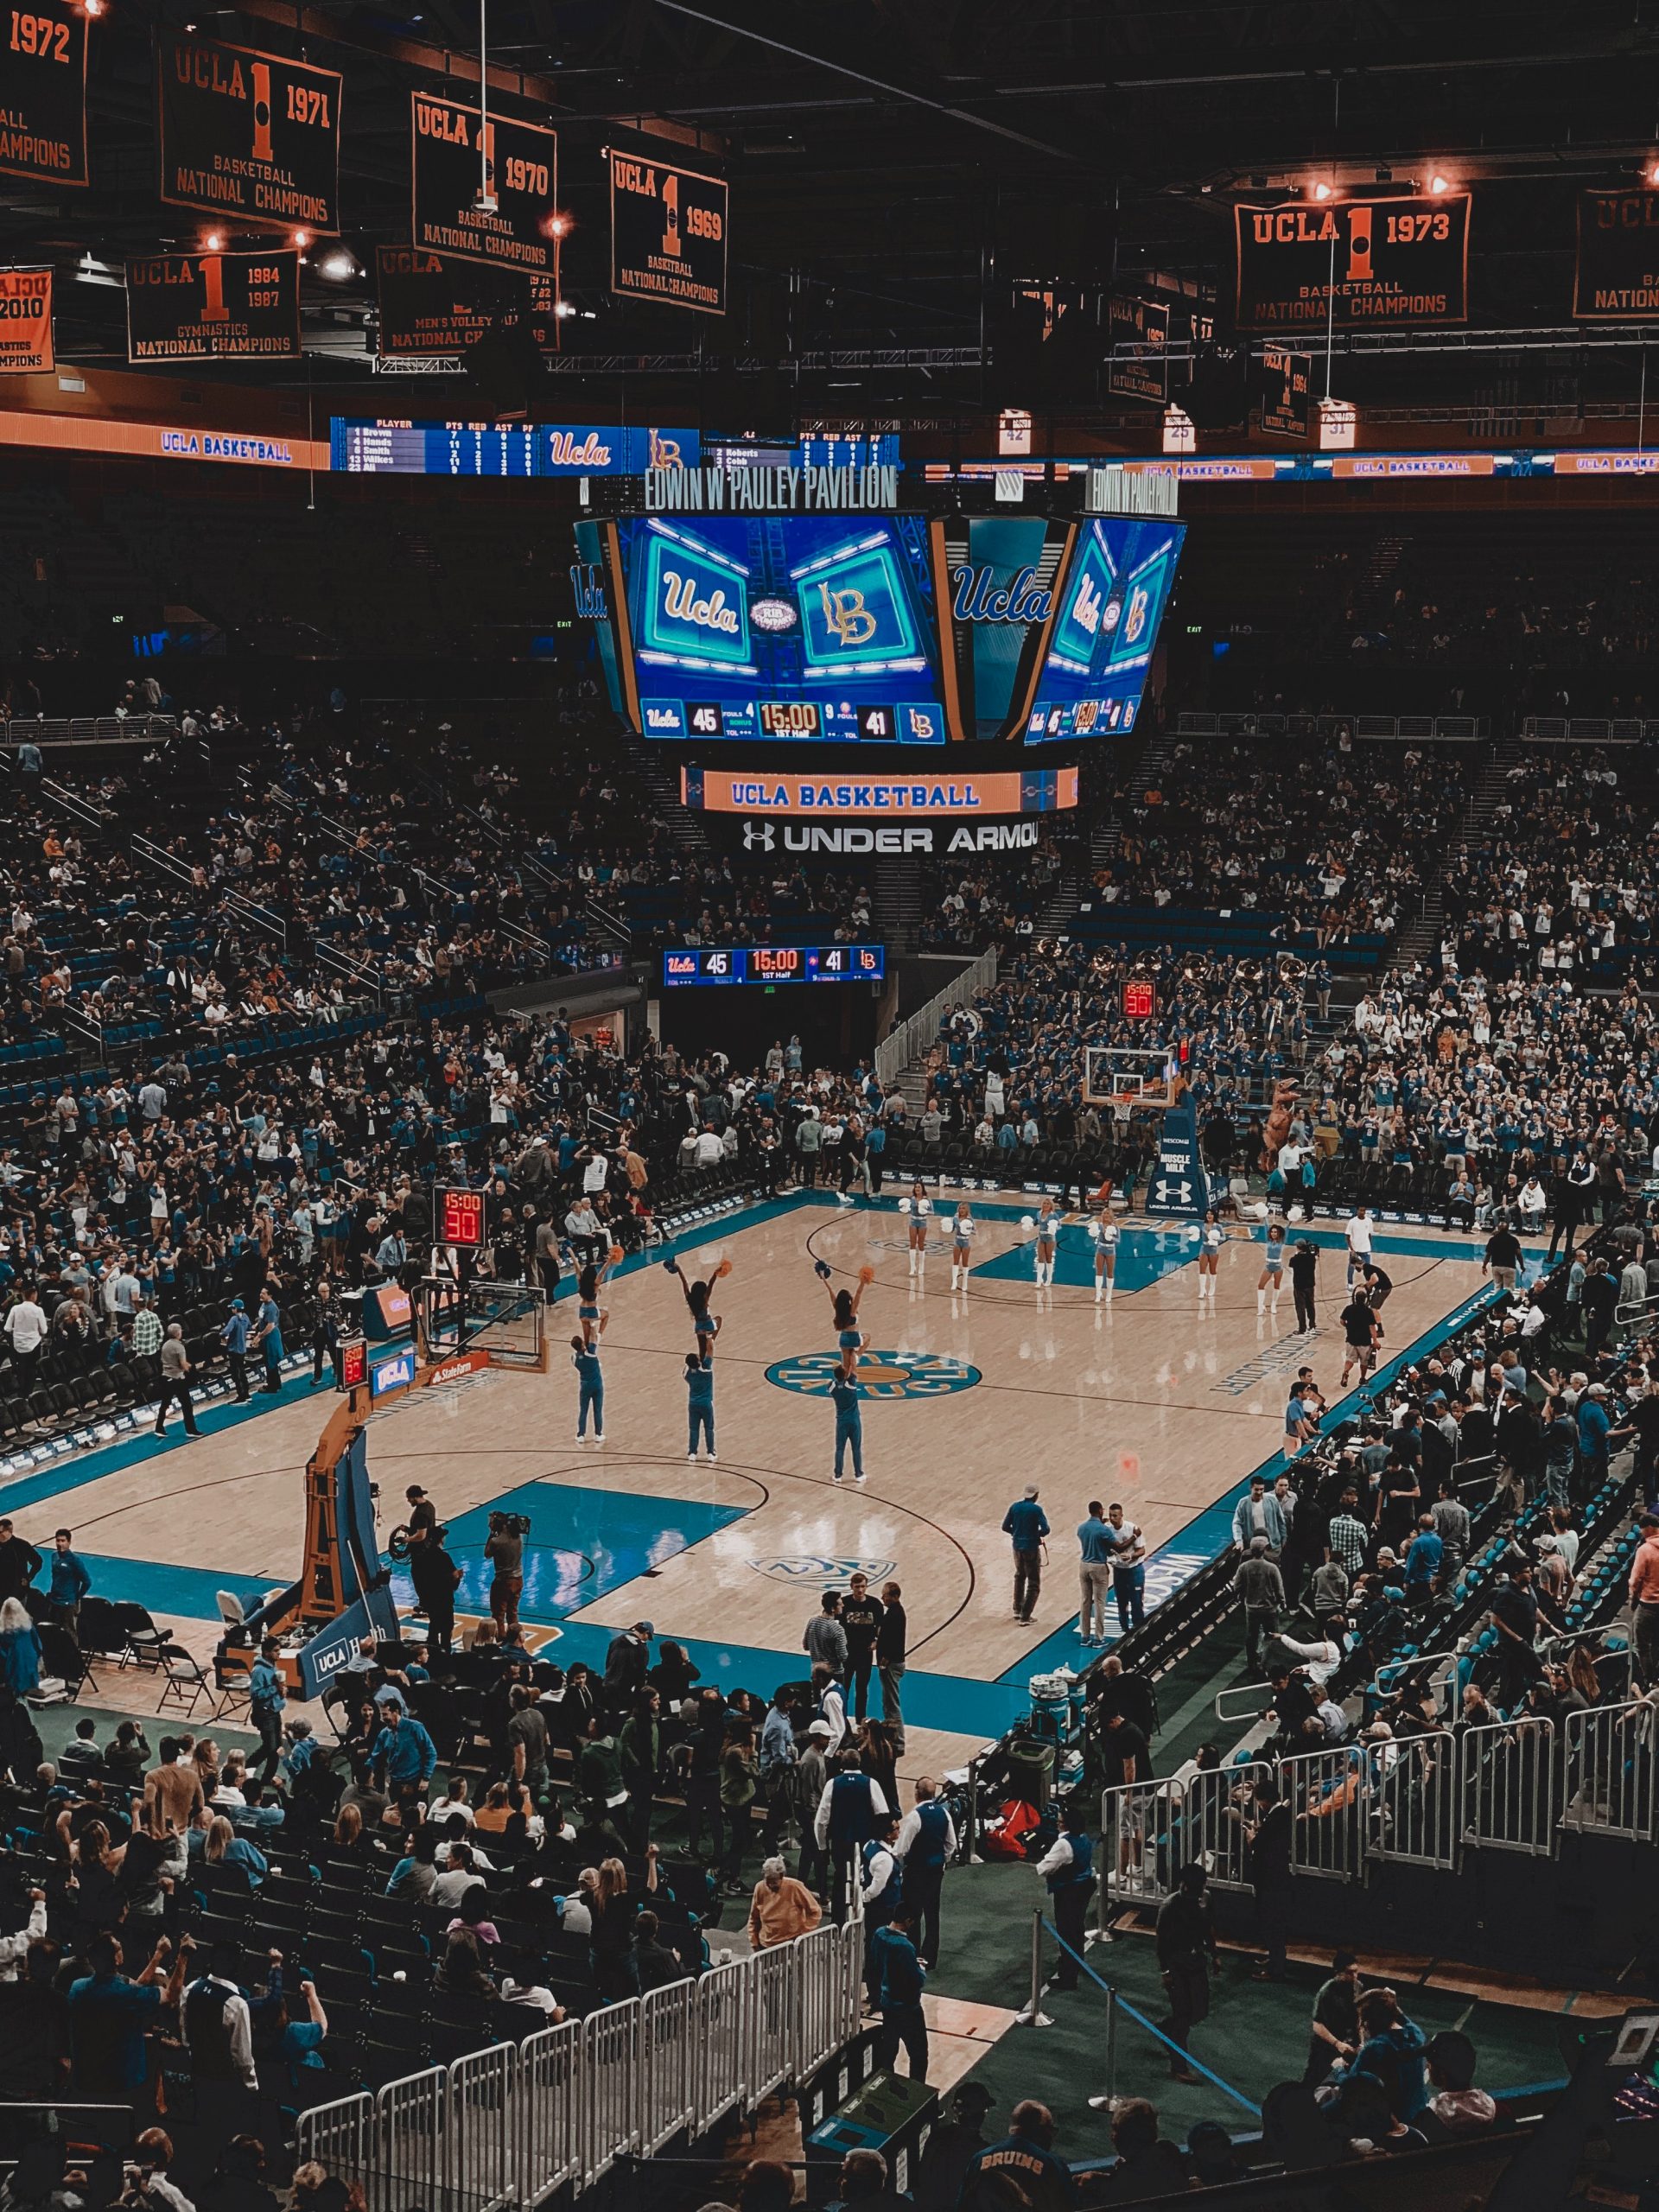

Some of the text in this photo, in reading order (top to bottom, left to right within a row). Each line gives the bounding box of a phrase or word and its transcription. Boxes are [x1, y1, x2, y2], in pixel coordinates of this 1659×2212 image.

[10, 11, 70, 64] 1972
[175, 44, 247, 100] UCLA
[287, 85, 330, 129] 1971
[417, 103, 469, 146] UCLA
[214, 155, 296, 187] BASKETBALL
[505, 156, 549, 196] 1970
[614, 161, 656, 197] UCLA
[177, 167, 328, 222] NATIONAL CHAMPIONS
[458, 209, 514, 236] BASKETBALL
[686, 206, 722, 241] 1969
[1253, 211, 1340, 243] UCLA
[1387, 213, 1449, 243] 1973
[423, 223, 546, 265] NATIONAL CHAMPIONS
[133, 260, 194, 285] UCLA
[382, 252, 443, 273] UCLA
[648, 255, 693, 277] BASKETBALL
[248, 267, 280, 283] 1984
[621, 269, 719, 304] NATIONAL CHAMPIONS
[1300, 282, 1403, 298] BASKETBALL
[0, 297, 43, 319] 2010
[248, 291, 280, 308] 1987
[1351, 295, 1446, 317] CHAMPIONS
[1595, 289, 1659, 308] NATION
[177, 323, 248, 338] GYMNASTICS
[416, 317, 448, 329] MEN'S
[137, 337, 290, 356] NATIONAL CHAMPIONS
[391, 331, 461, 346] NATIONAL
[354, 428, 360, 436] 1
[363, 428, 391, 437] Brown
[377, 419, 412, 429] PLAYER
[468, 423, 486, 431] REB
[495, 423, 512, 432] AST
[162, 433, 291, 462] UCLA BASKETBALL
[353, 437, 480, 449] 4 Hands 11 1
[799, 432, 880, 442] PTS REB AST PF
[363, 446, 458, 458] Smith 2
[550, 431, 611, 467] Ucla
[716, 448, 759, 458] 2 Roberts
[348, 463, 361, 472] 23
[349, 455, 361, 464] 13
[449, 457, 460, 467] 11
[1178, 465, 1252, 475] BASKETBALL
[1354, 461, 1469, 473] UCLA BASKETBALL
[1577, 457, 1610, 469] UCLA
[645, 465, 898, 511] EDWIN W PAULEY PAVILION
[1093, 468, 1121, 512] EDWIN
[663, 571, 740, 634] Ucla
[954, 565, 1054, 623] Ucla
[817, 581, 876, 648] LB
[647, 709, 680, 728] Ucla
[694, 709, 716, 731] 45
[746, 702, 754, 717] 4
[761, 703, 816, 730] 15:00
[825, 704, 834, 719] 9
[775, 729, 791, 738] 1ST
[866, 712, 886, 734] 41
[732, 783, 980, 807] UCLA BASKETBALL
[784, 827, 933, 853] UNDER
[668, 957, 696, 973] Ucla
[706, 953, 727, 974] 45
[753, 950, 798, 971] 15:00
[825, 950, 841, 971] 41
[1128, 984, 1152, 995] 15:00
[1128, 996, 1147, 1014] 30
[1160, 1154, 1191, 1164] MUSCLE
[1166, 1163, 1185, 1173] MILK
[445, 1193, 480, 1210] 15:00
[448, 1211, 475, 1239] 30
[378, 1362, 410, 1390] UCLA
[442, 1362, 471, 1381] StateFarm
[319, 1648, 346, 1672] UCLA
[982, 2152, 1044, 2174] BRUINS
